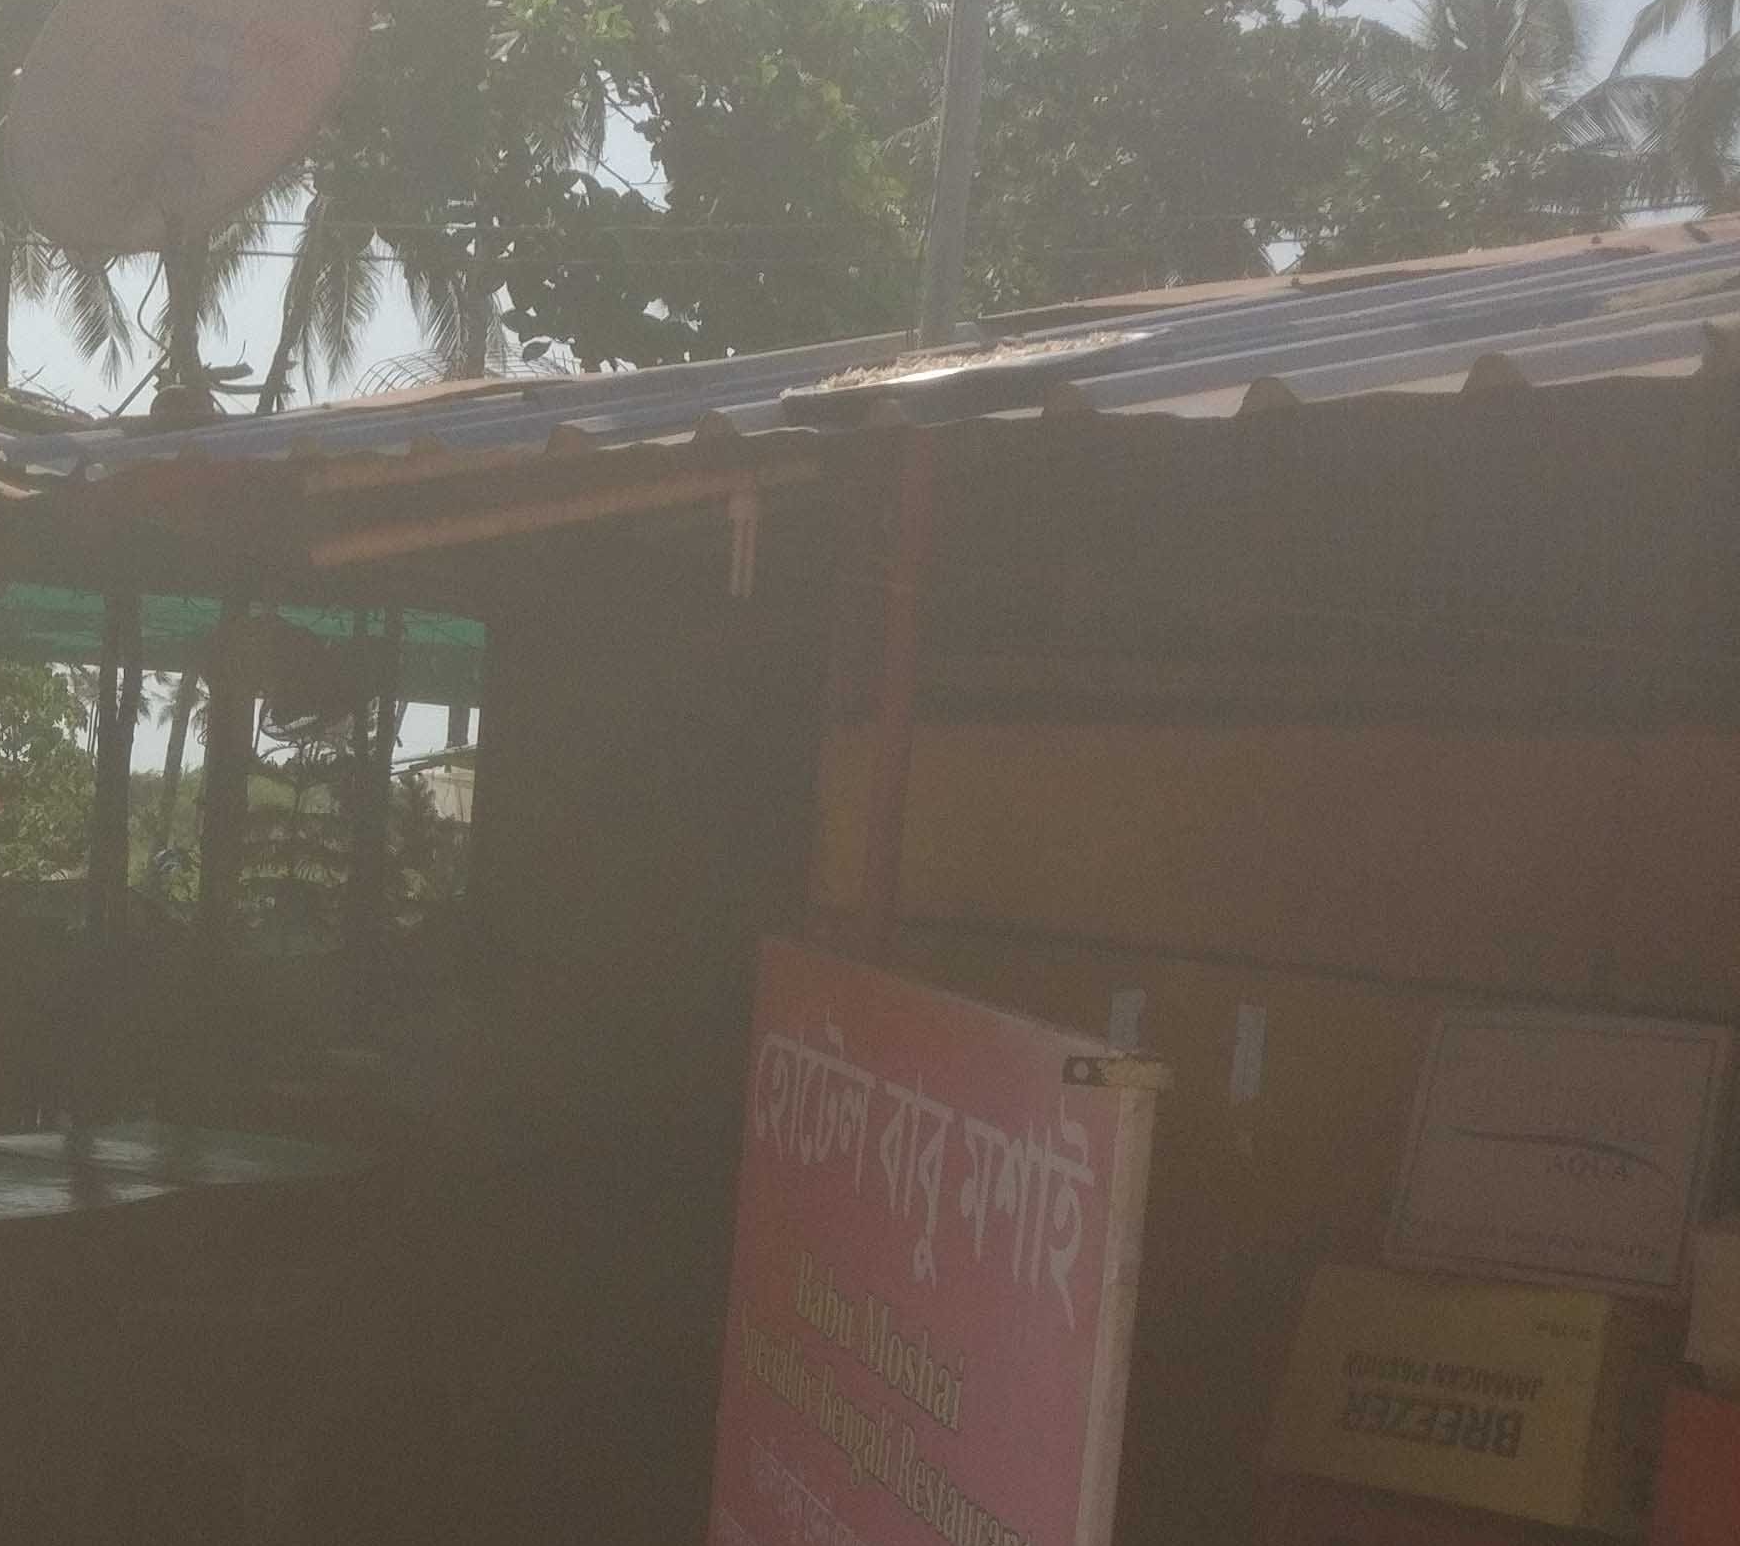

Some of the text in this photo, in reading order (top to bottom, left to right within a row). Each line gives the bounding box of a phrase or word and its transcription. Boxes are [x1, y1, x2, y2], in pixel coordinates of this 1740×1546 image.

[756, 1009, 1095, 1331] হোটেল বাবু মশাই
[794, 1251, 965, 1435] Babu Moshai
[817, 1363, 894, 1489] Bengali
[1337, 1389, 1524, 1458] BREEZER
